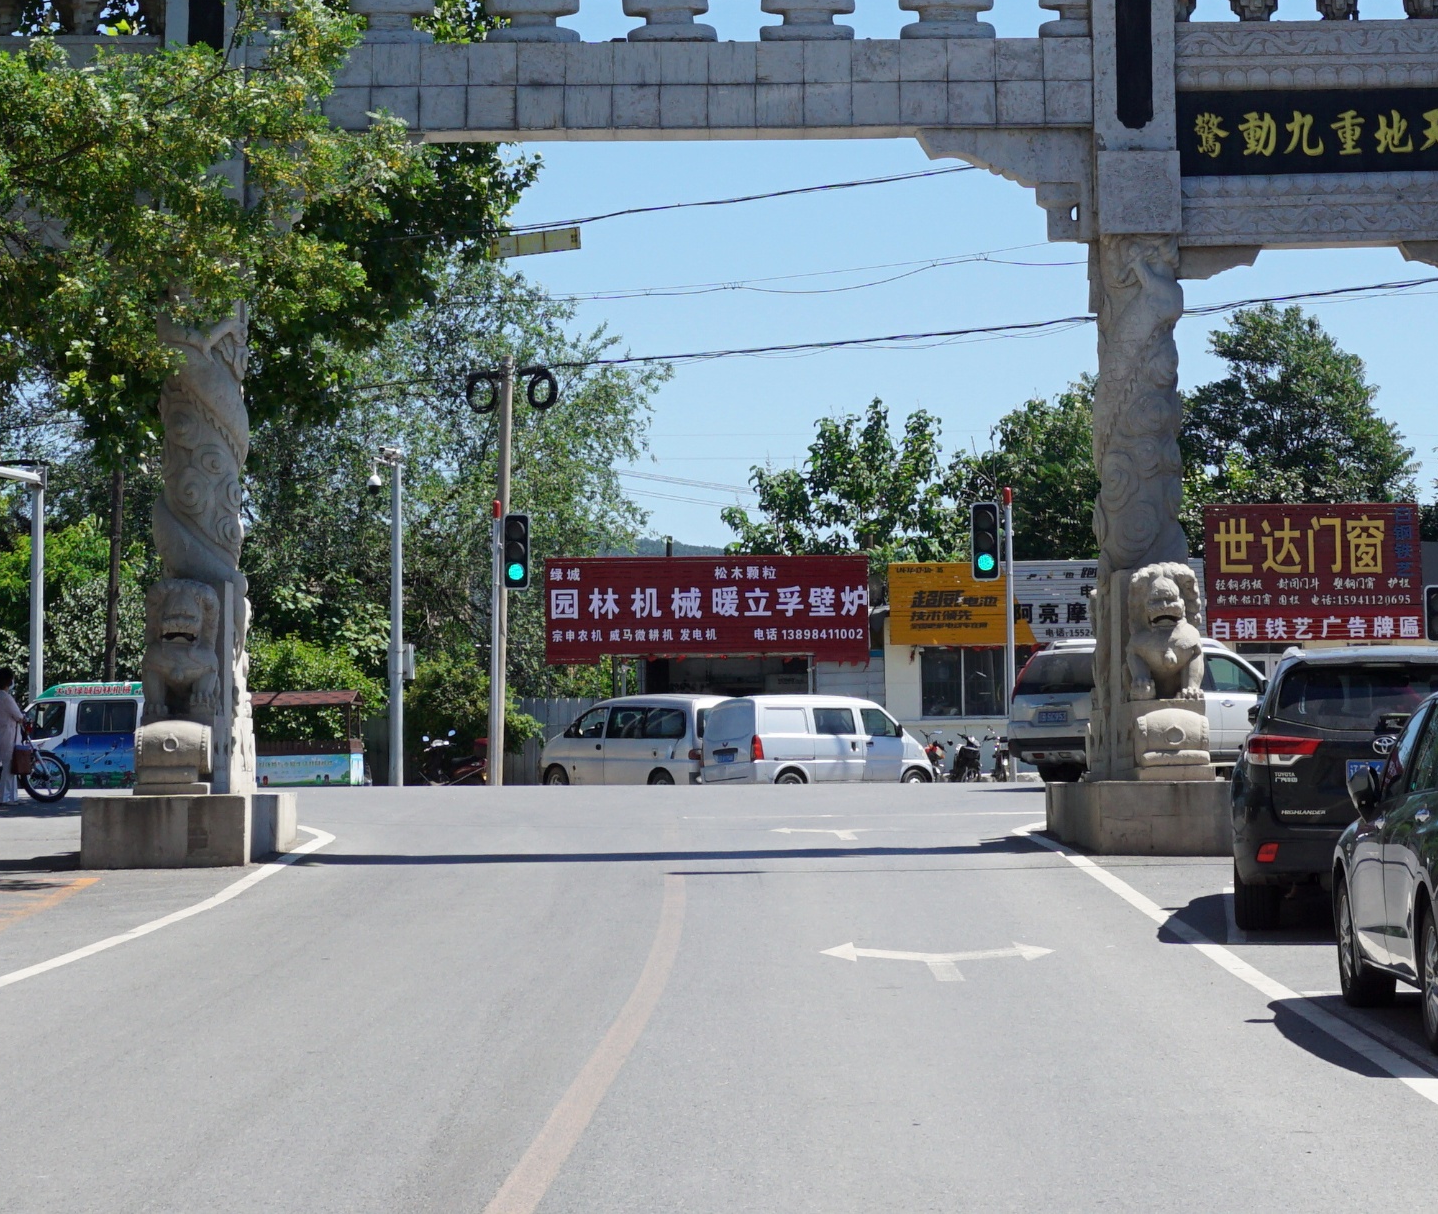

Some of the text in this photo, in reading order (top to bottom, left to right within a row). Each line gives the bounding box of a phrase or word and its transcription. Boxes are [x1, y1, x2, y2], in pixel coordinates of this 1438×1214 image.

[1214, 515, 1385, 574] 世达门窗
[1394, 507, 1413, 576] 白钢铁艺
[550, 565, 777, 581] 绿城 松木颗粒
[1215, 577, 1411, 591] 轻钢彩板 封闭门斗 塑钢门窗 护栏
[550, 585, 869, 619] 园林机械 暖立孚壁炉
[1278, 594, 1300, 606] 围栏
[551, 627, 864, 643] 宗申农机 威马微耕机 发电机 电话 13898411002
[1211, 616, 1420, 640] 白钢铁艺广告牌匾
